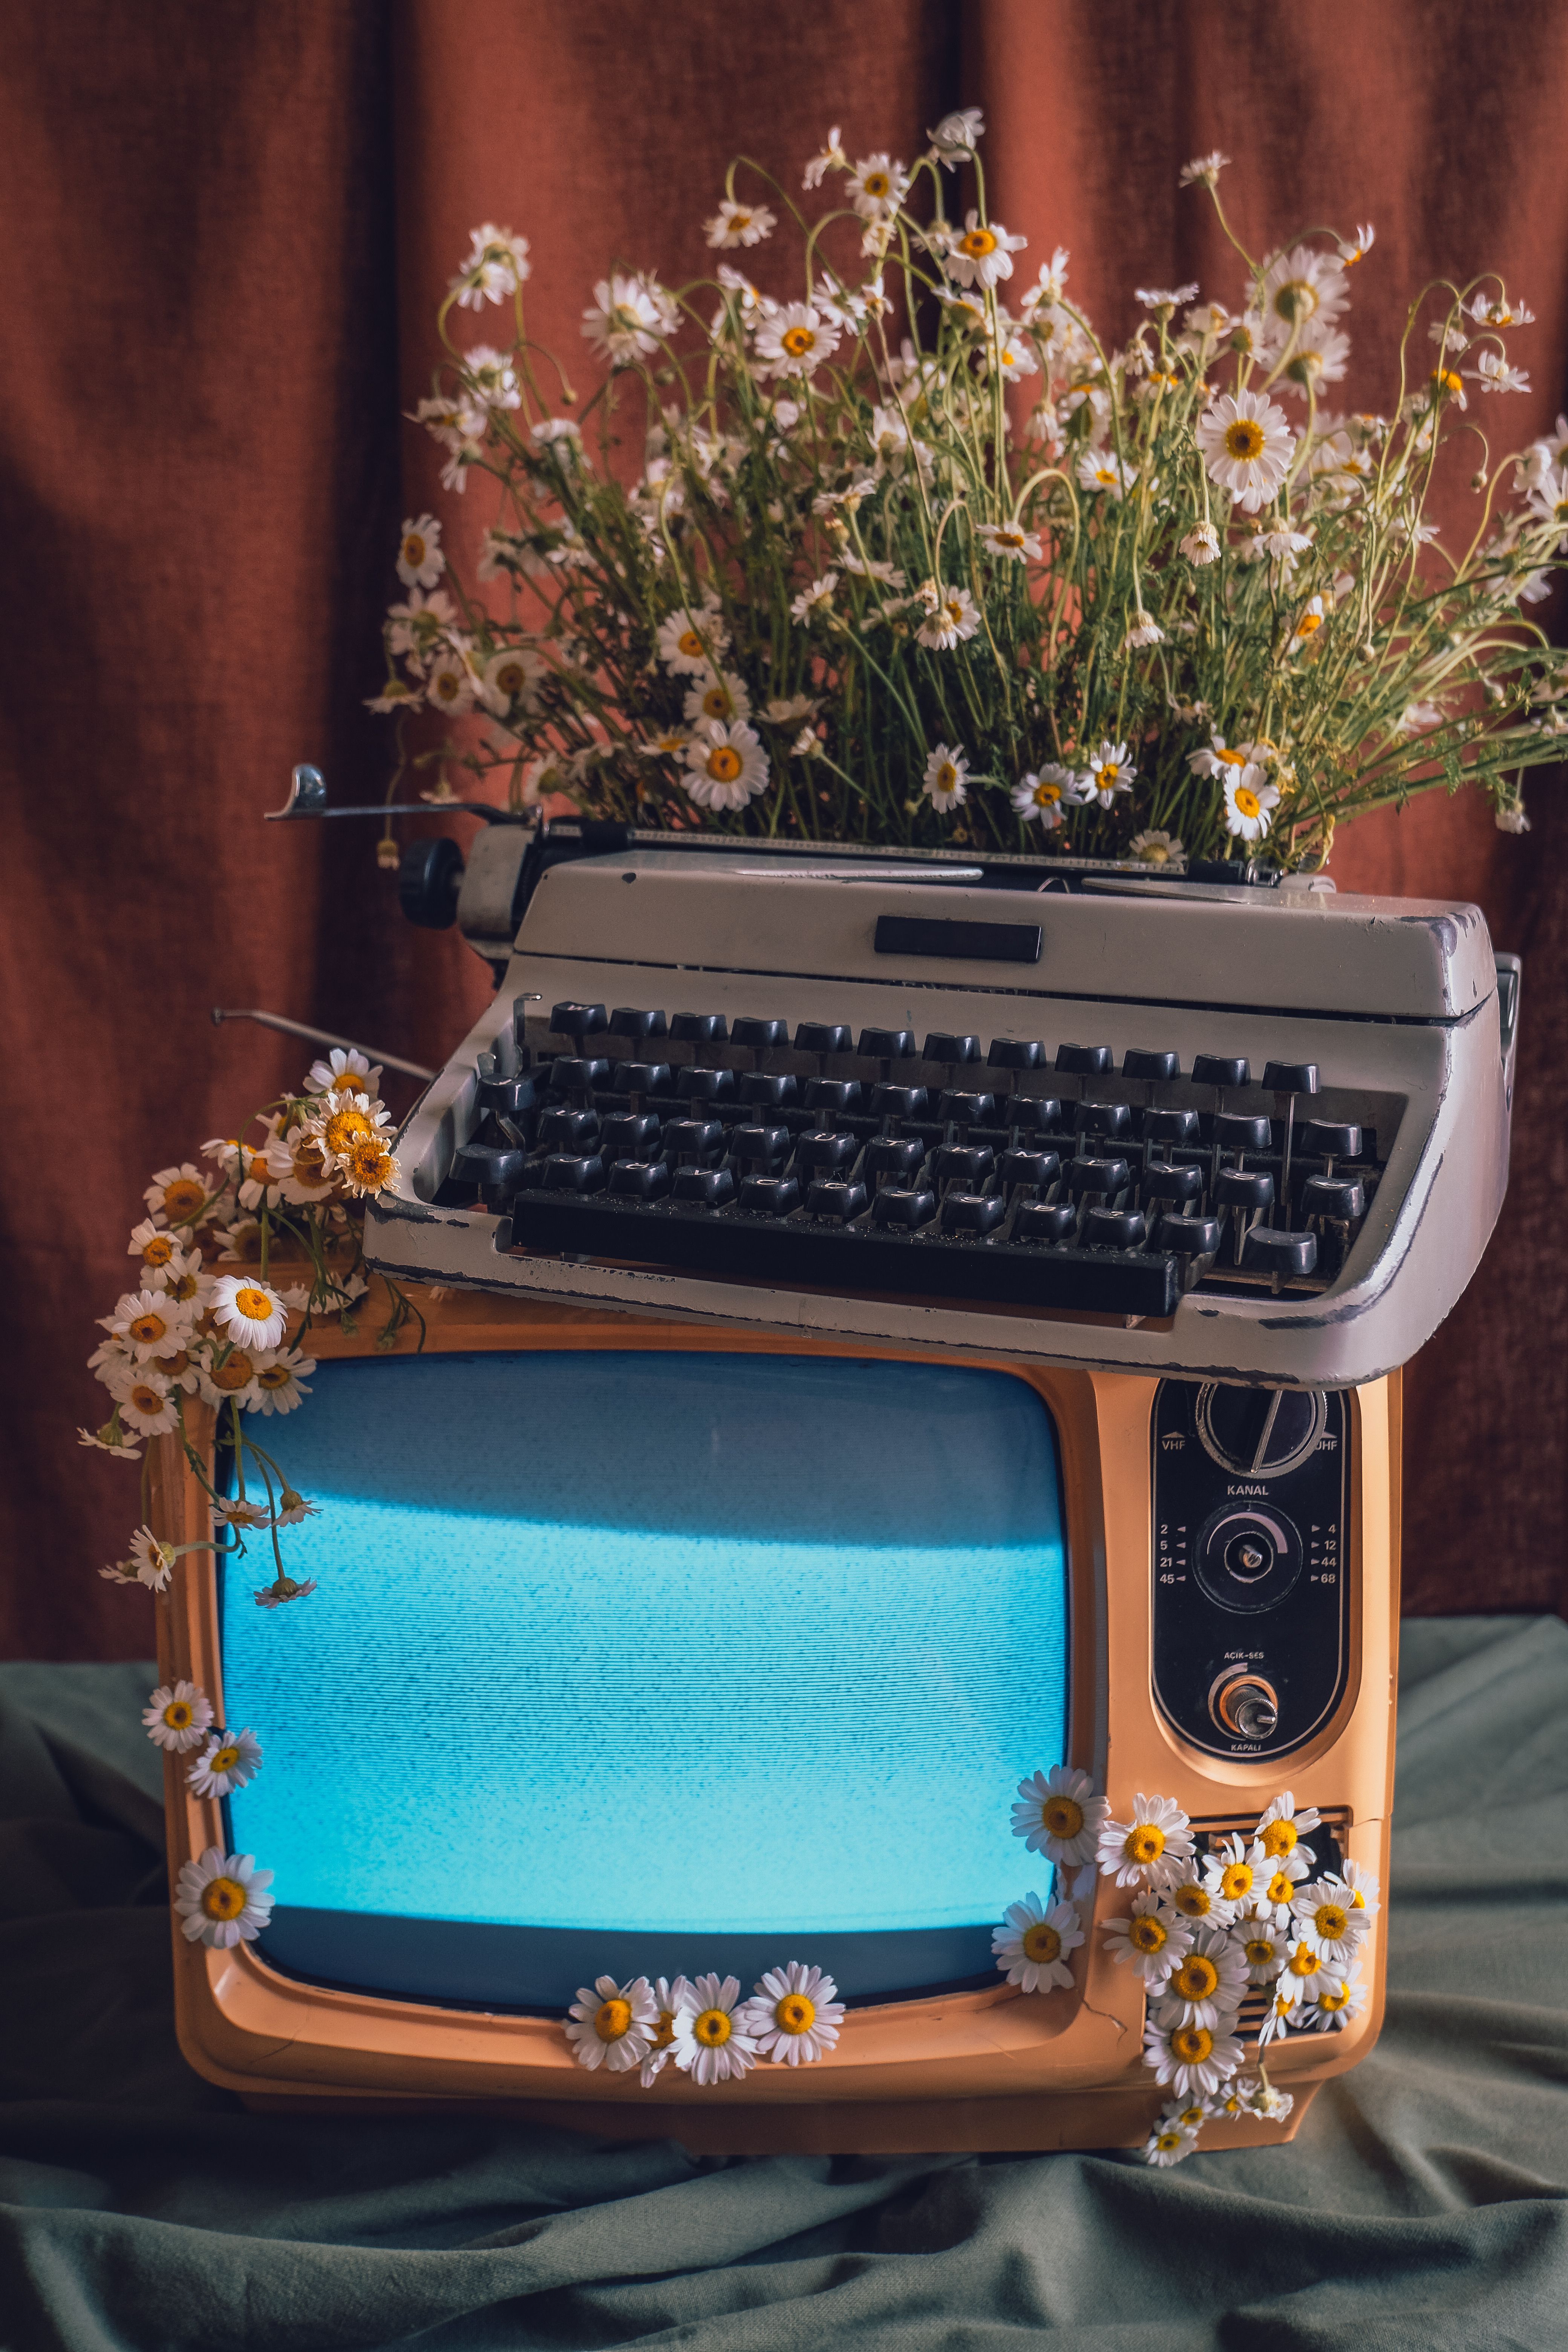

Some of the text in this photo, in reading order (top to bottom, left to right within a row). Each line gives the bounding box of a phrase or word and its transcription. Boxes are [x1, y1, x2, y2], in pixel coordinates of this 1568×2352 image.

[1162, 1440, 1185, 1450] VHF
[1227, 1485, 1269, 1496] KANAL
[1160, 1525, 1168, 1534] 2
[1328, 1524, 1337, 1534] 4
[1160, 1540, 1168, 1550] 5
[1324, 1540, 1337, 1550] 12
[1159, 1557, 1173, 1567] 21
[1321, 1557, 1337, 1567] 44
[1159, 1574, 1174, 1584] 45
[1321, 1574, 1336, 1583] 68
[1224, 1651, 1265, 1660] AÇIK-SES
